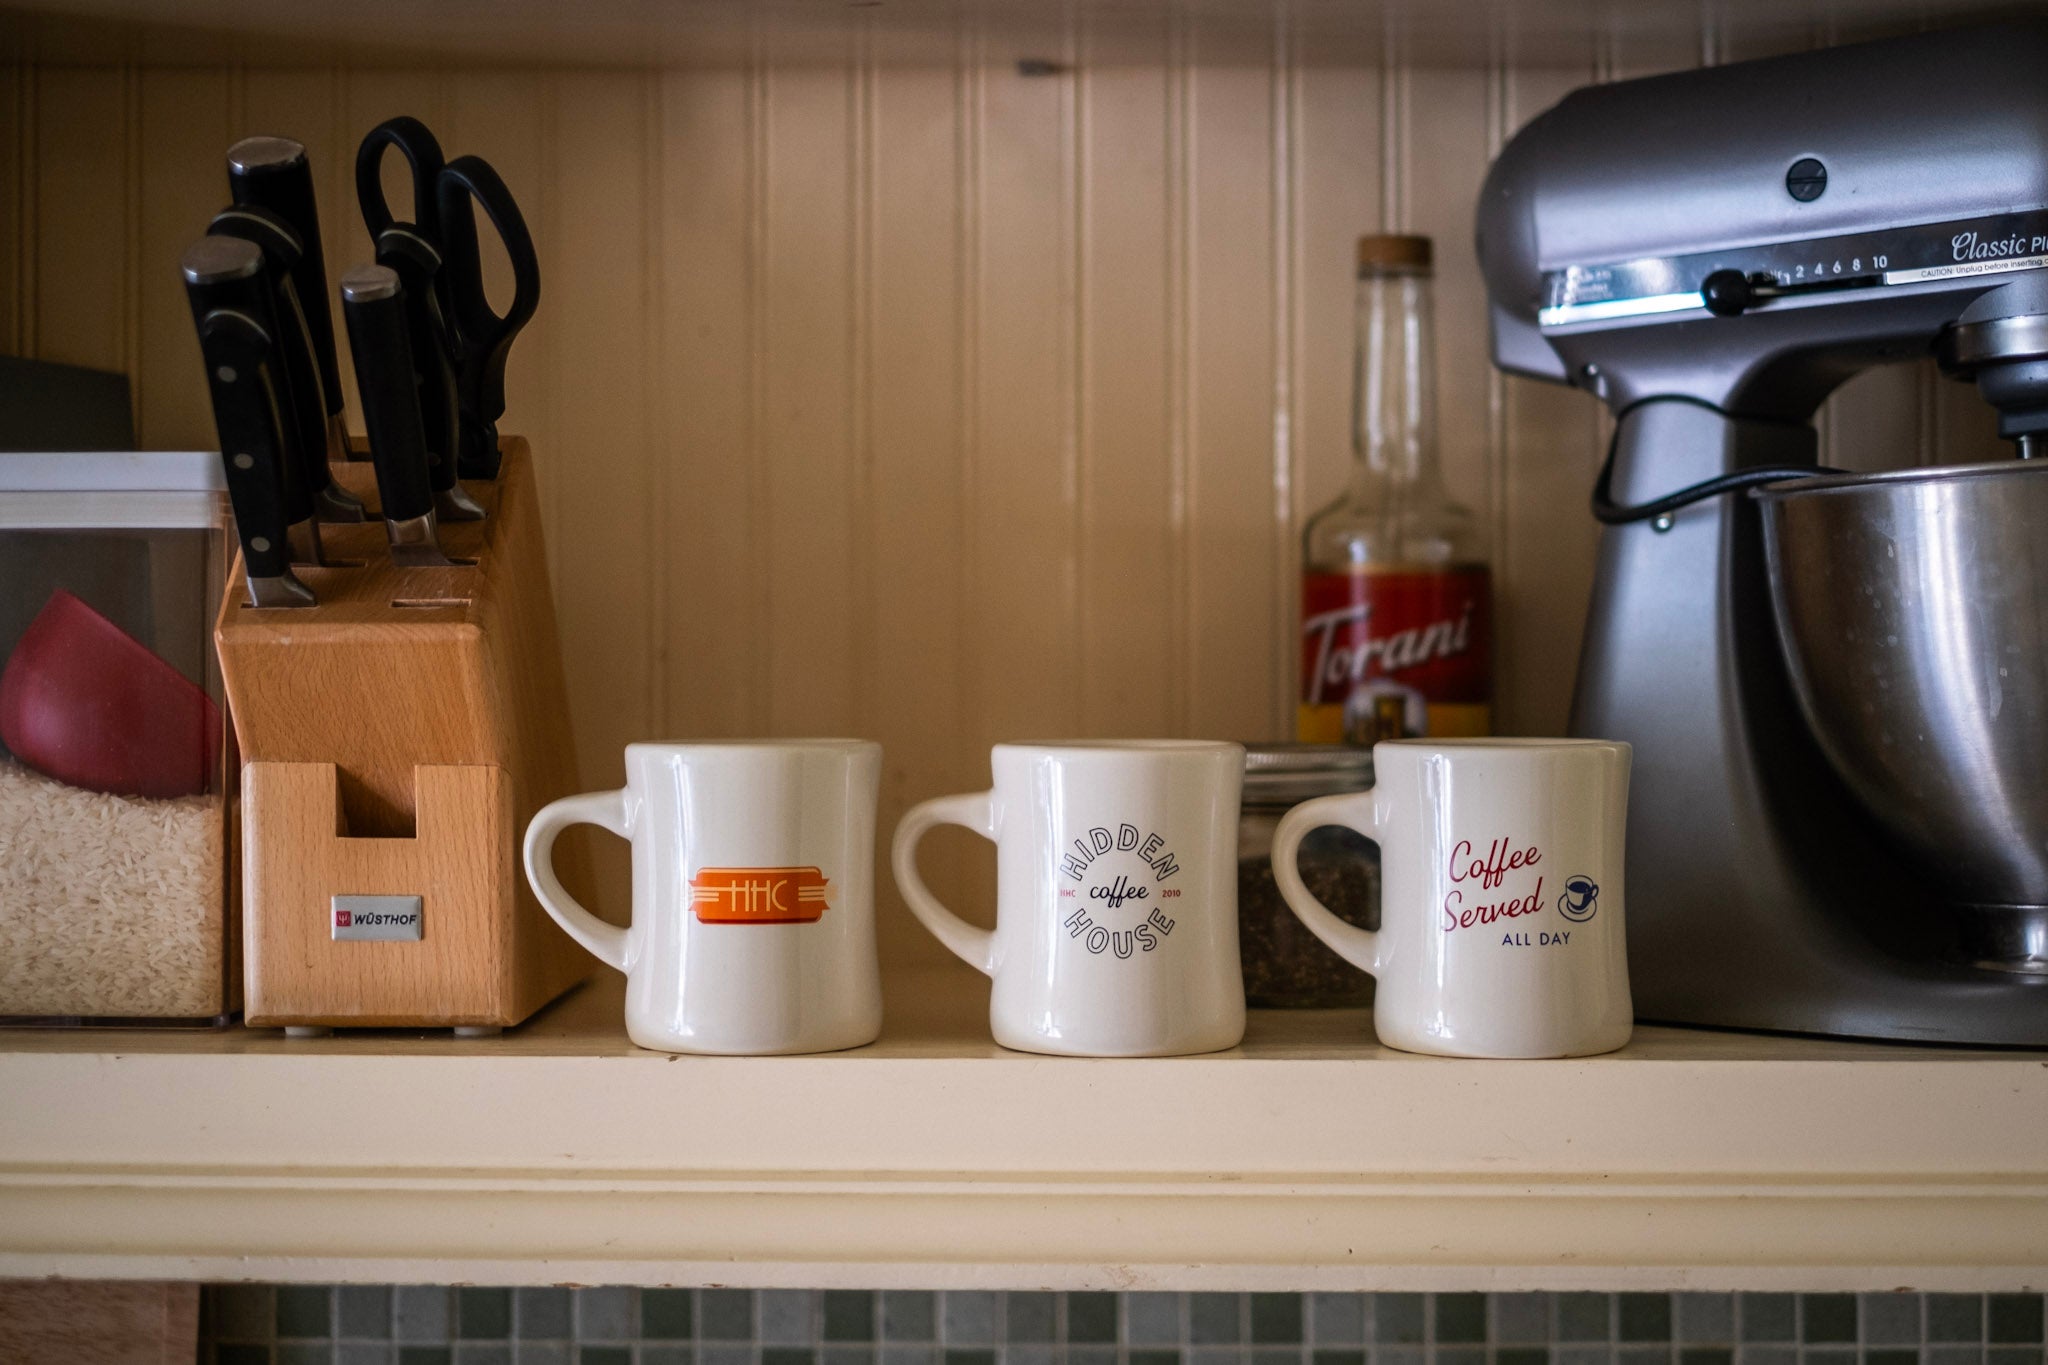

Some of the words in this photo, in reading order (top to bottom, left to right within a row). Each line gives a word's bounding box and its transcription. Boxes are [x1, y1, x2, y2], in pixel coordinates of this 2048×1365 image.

[1951, 232, 2026, 261] Classic
[1796, 265, 1805, 279] 2
[1814, 262, 1824, 276] 4
[1832, 260, 1842, 274] 6
[1852, 258, 1861, 271] 8
[1873, 255, 1888, 269] 10
[1956, 262, 1983, 275] Unplug
[1984, 261, 2009, 271] before
[2010, 258, 2042, 268] inserting
[1304, 601, 1475, 705] Torani
[1060, 823, 1180, 882] HIDDEN
[1449, 836, 1543, 890] Coffee
[731, 879, 788, 913] HHC
[1089, 875, 1150, 908] coffee
[1162, 889, 1182, 898] 2010
[1443, 876, 1545, 933] Served
[354, 911, 418, 925] WÜSTHOF
[1063, 907, 1176, 960] HOUSE
[1501, 932, 1532, 946] ALL
[1539, 931, 1571, 946] DAY
